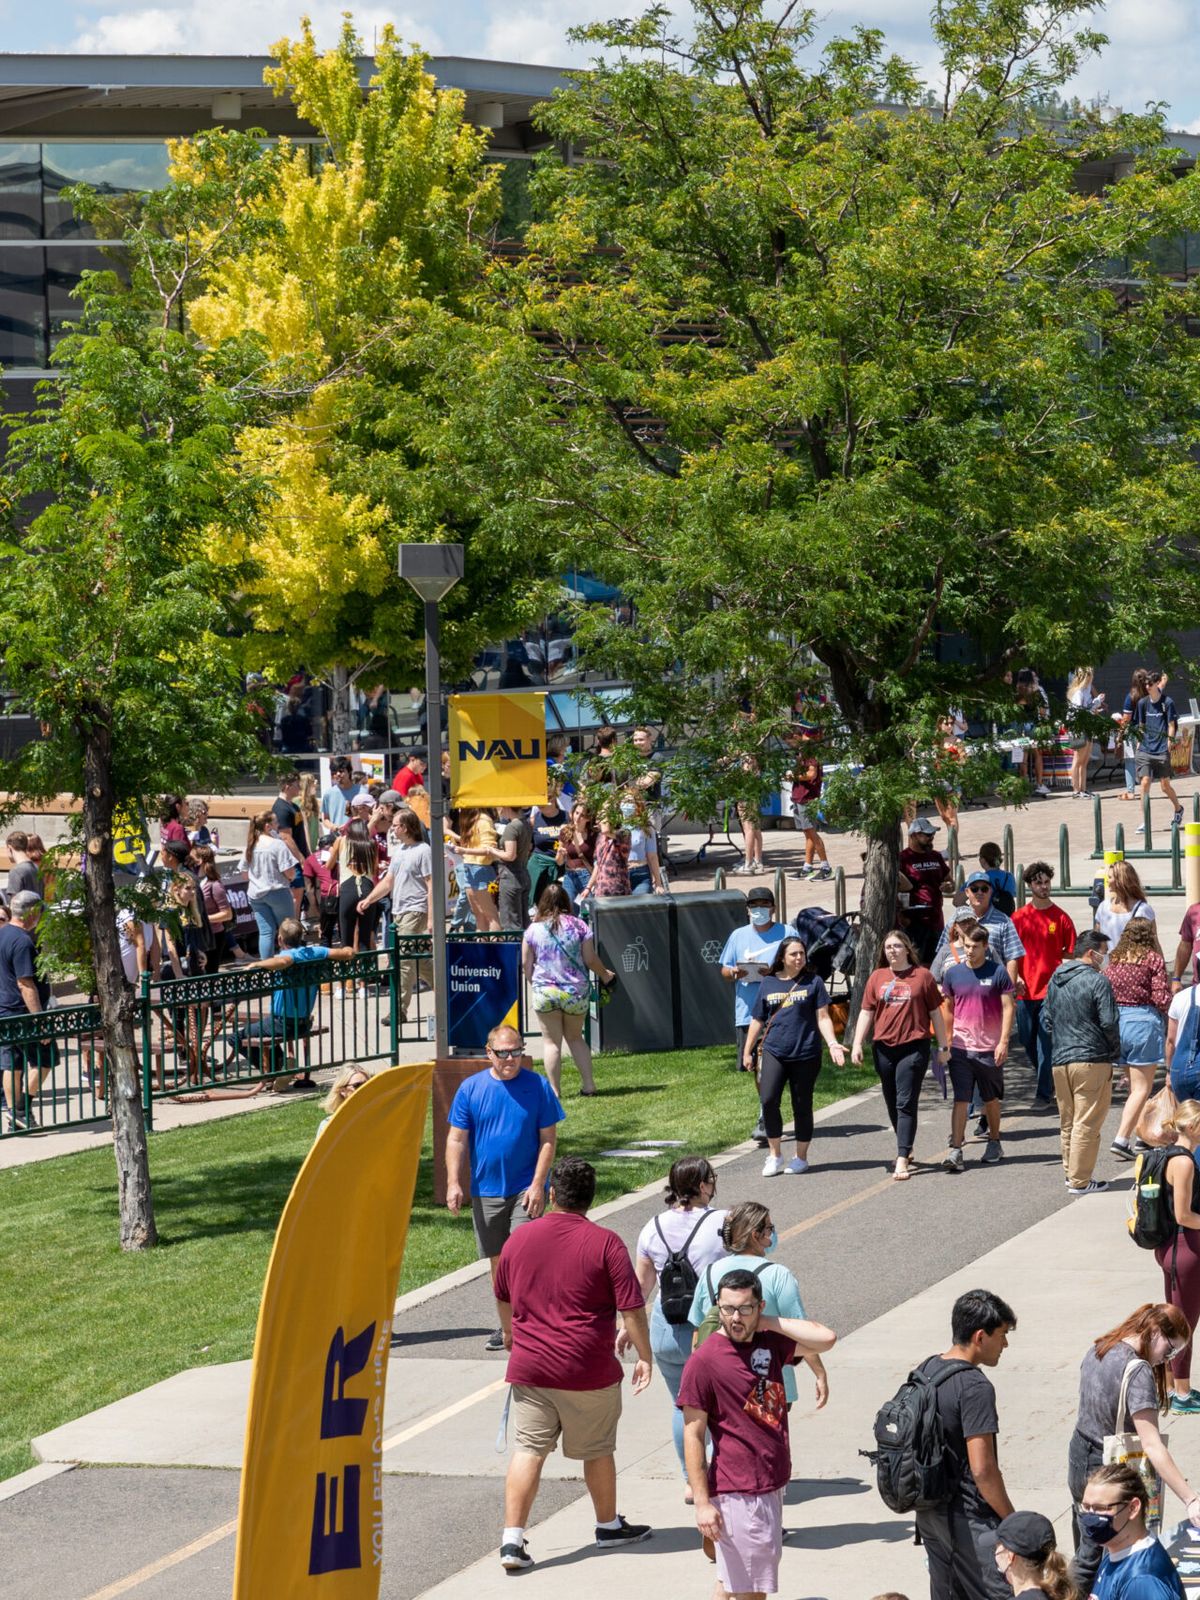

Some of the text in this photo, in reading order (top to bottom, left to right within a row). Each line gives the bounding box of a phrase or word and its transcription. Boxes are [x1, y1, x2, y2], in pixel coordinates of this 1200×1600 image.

[457, 738, 541, 761] NAU
[450, 964, 502, 980] University
[450, 980, 480, 992] Union
[371, 1395, 383, 1500] BELO
[372, 1510, 383, 1566] YOU
